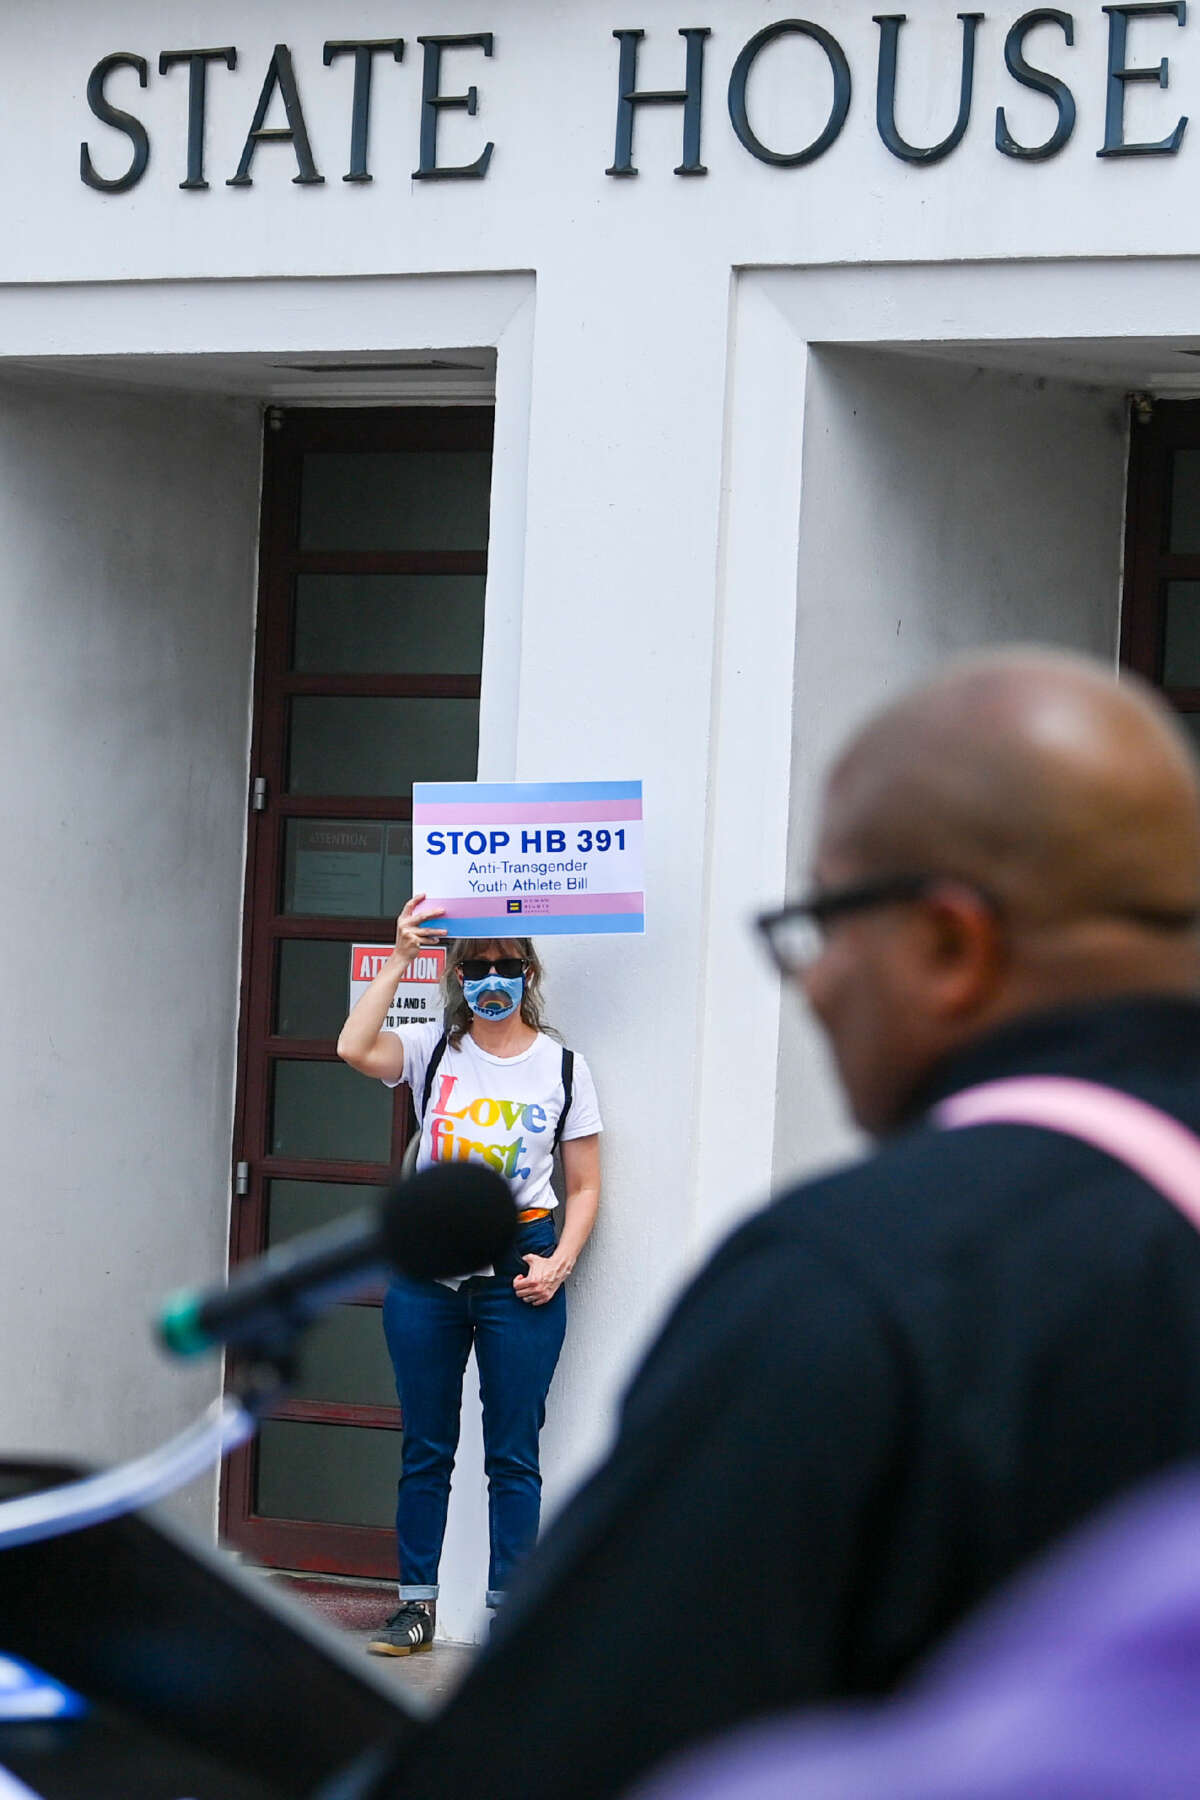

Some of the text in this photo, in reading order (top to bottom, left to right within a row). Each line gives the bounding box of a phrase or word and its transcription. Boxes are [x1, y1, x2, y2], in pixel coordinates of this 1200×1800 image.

[80, 32, 495, 193] STATE
[603, 1, 1190, 177] HOUSE
[426, 830, 510, 856] STOP
[521, 829, 566, 853] HB
[577, 829, 625, 852] 391
[468, 859, 588, 875] Anti-Transgender
[468, 877, 588, 893] Youth Athlete Bill
[404, 998, 419, 1009] AND
[431, 1074, 547, 1133] Love
